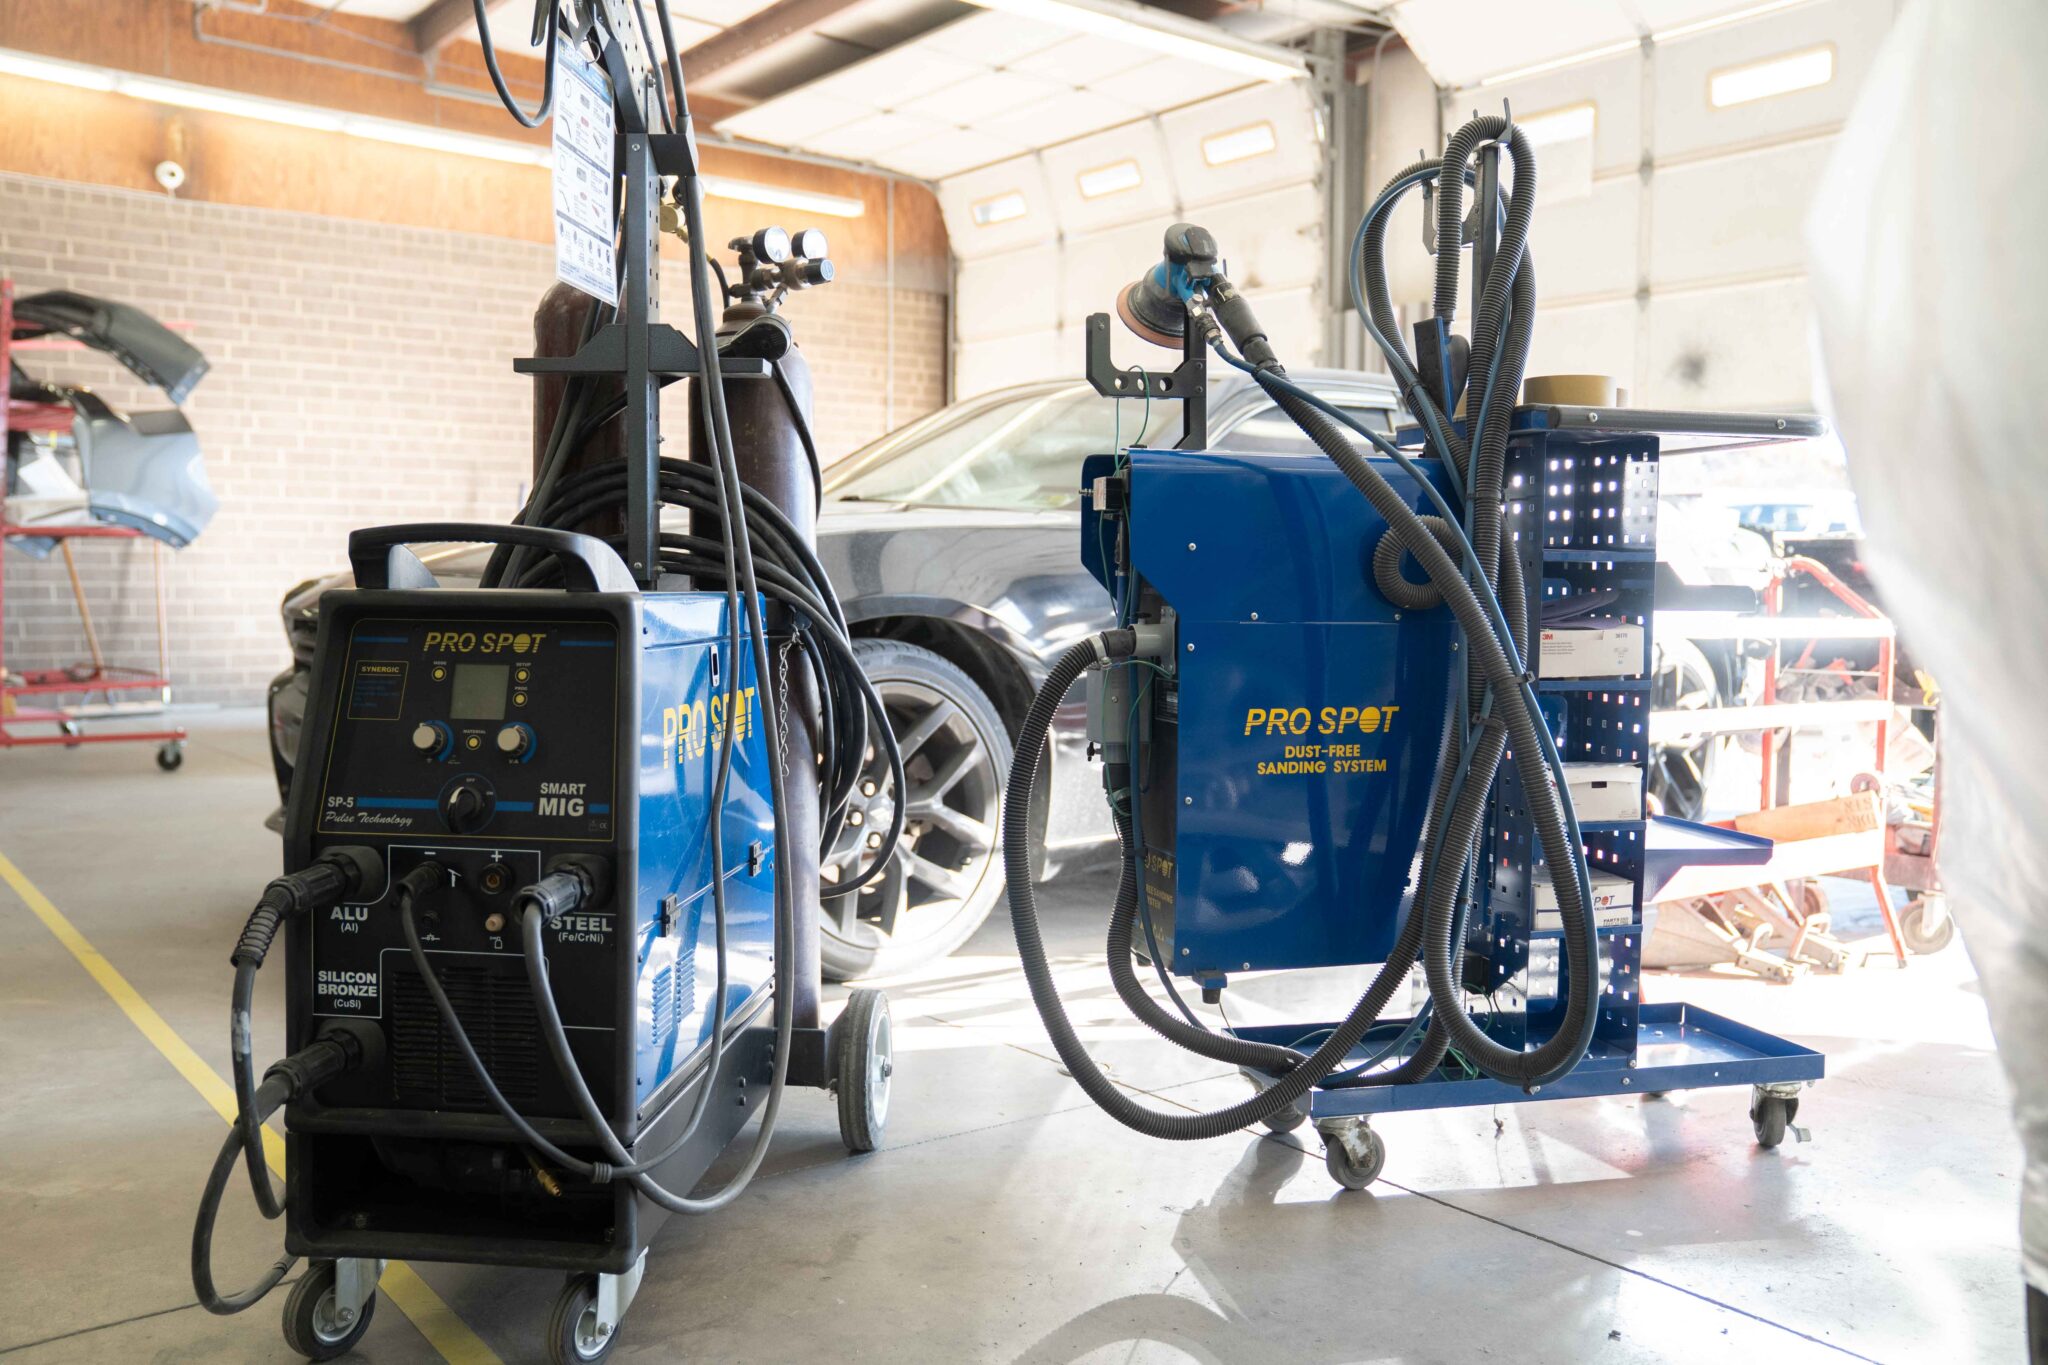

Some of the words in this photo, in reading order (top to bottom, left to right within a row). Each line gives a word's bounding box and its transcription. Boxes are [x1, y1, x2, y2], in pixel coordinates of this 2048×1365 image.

[424, 632, 476, 652] PRO
[481, 633, 547, 653] SPOT
[361, 665, 400, 673] SYNERGIC
[1244, 707, 1311, 736] PRO
[1318, 706, 1400, 735] SPOT
[663, 699, 707, 769] PRO
[1284, 744, 1361, 759] DUST-FREE
[1257, 761, 1327, 775] SANDING
[1333, 759, 1387, 773] SYSTEM
[540, 782, 587, 795] SMART
[327, 796, 354, 808] SP-5
[538, 797, 585, 817] MIG
[325, 811, 355, 823] Pulse
[357, 812, 413, 827] Technology
[1593, 895, 1615, 906] POT
[330, 906, 368, 921] ALU
[550, 916, 613, 932] STEEL
[558, 931, 604, 945] (Fe/CrNi)
[318, 970, 377, 984] SILICON
[318, 983, 378, 997] BRONZE
[333, 998, 361, 1010] (CuSi)
